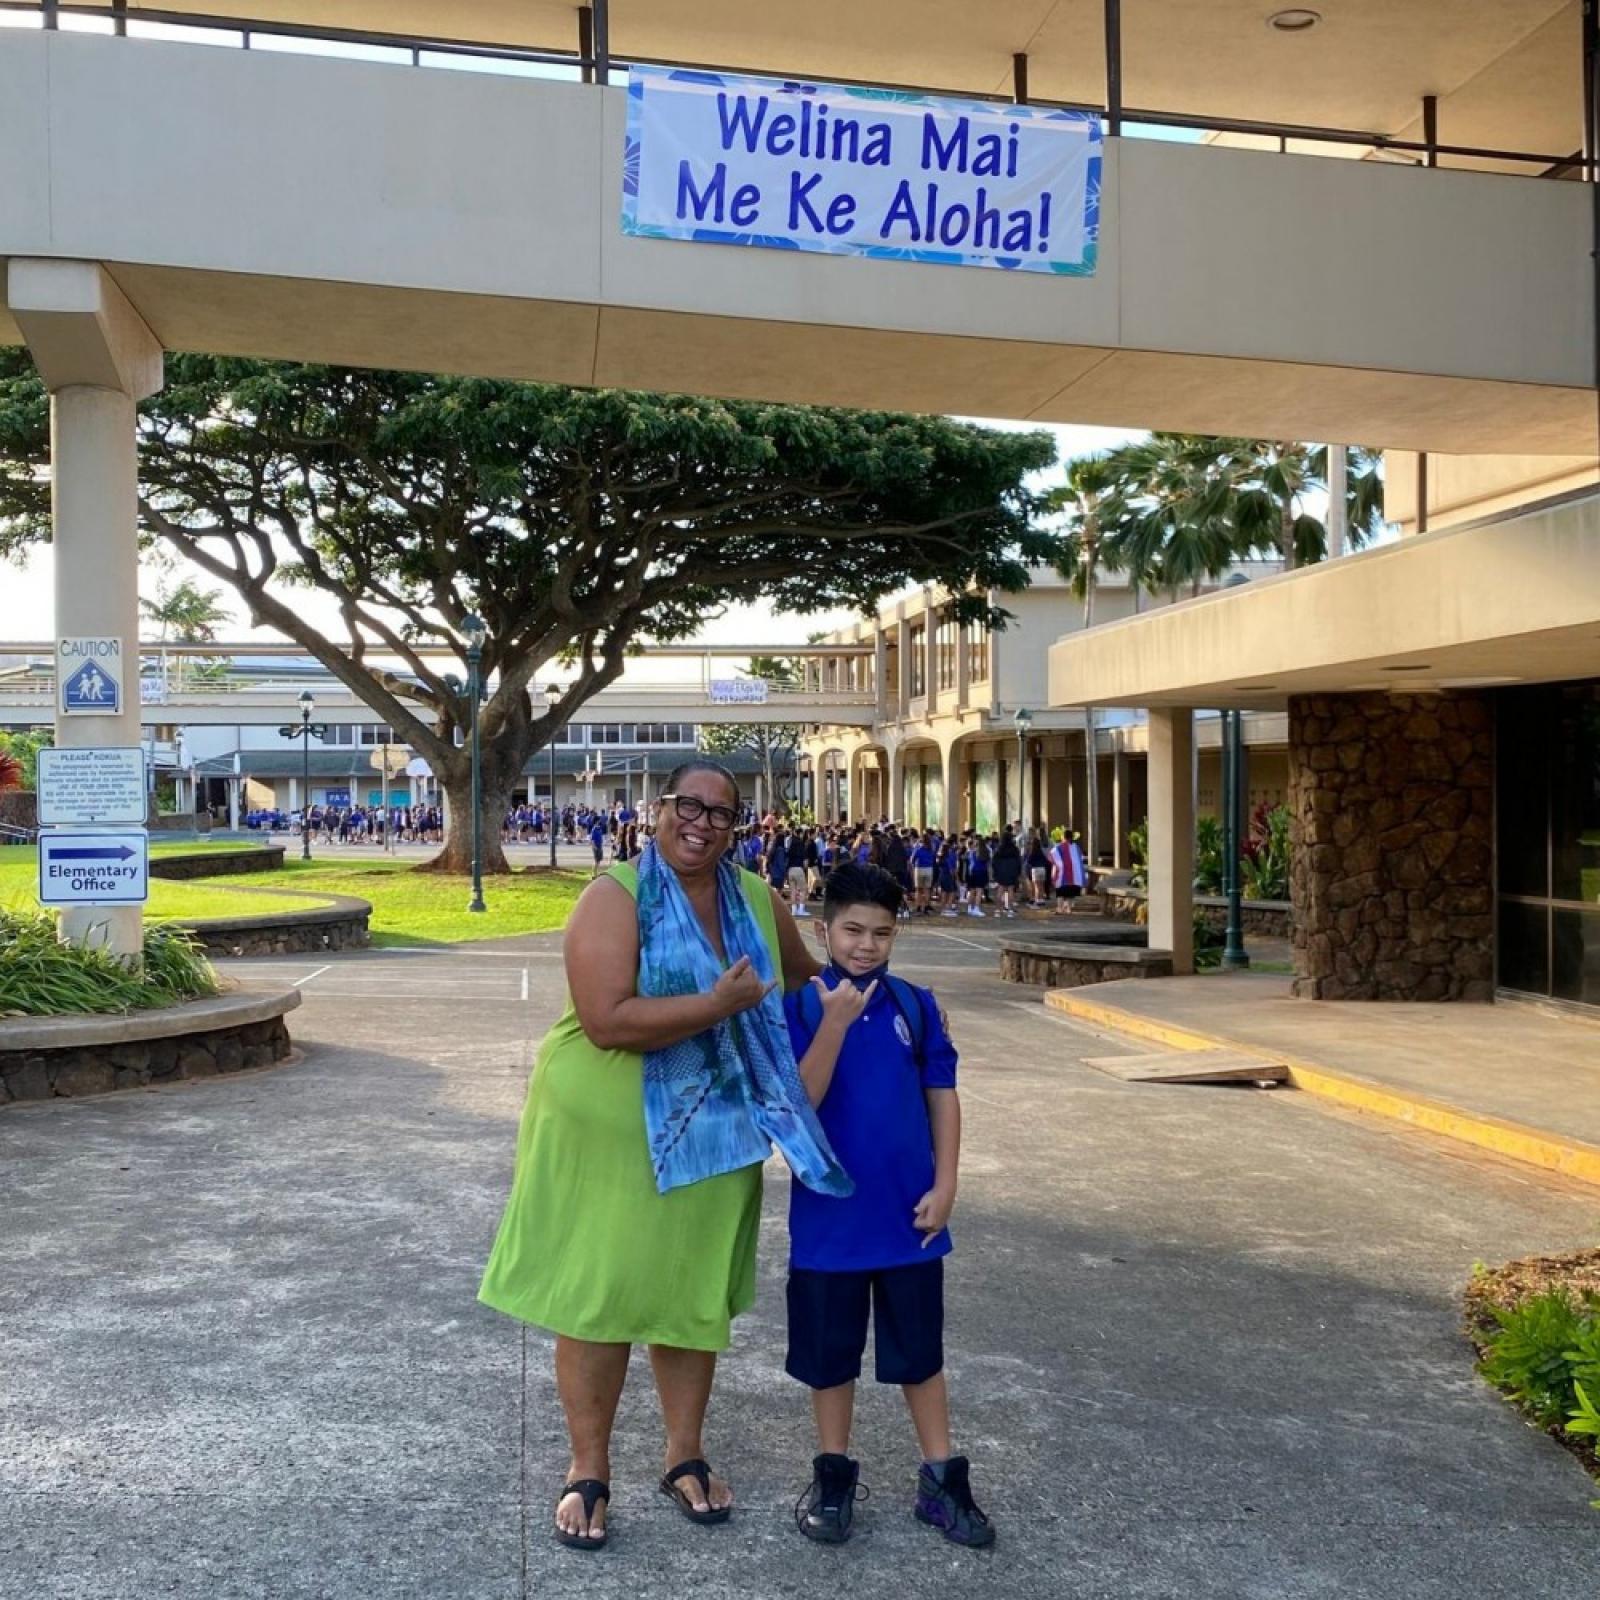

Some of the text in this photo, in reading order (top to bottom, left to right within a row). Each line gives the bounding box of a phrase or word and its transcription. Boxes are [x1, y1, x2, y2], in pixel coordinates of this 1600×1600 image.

[716, 92, 1020, 178] Welina Mai
[675, 159, 1053, 254] Me Ke Aloha!
[60, 640, 119, 657] CAUTION
[49, 864, 138, 879] Elementary
[71, 878, 116, 890] Office
